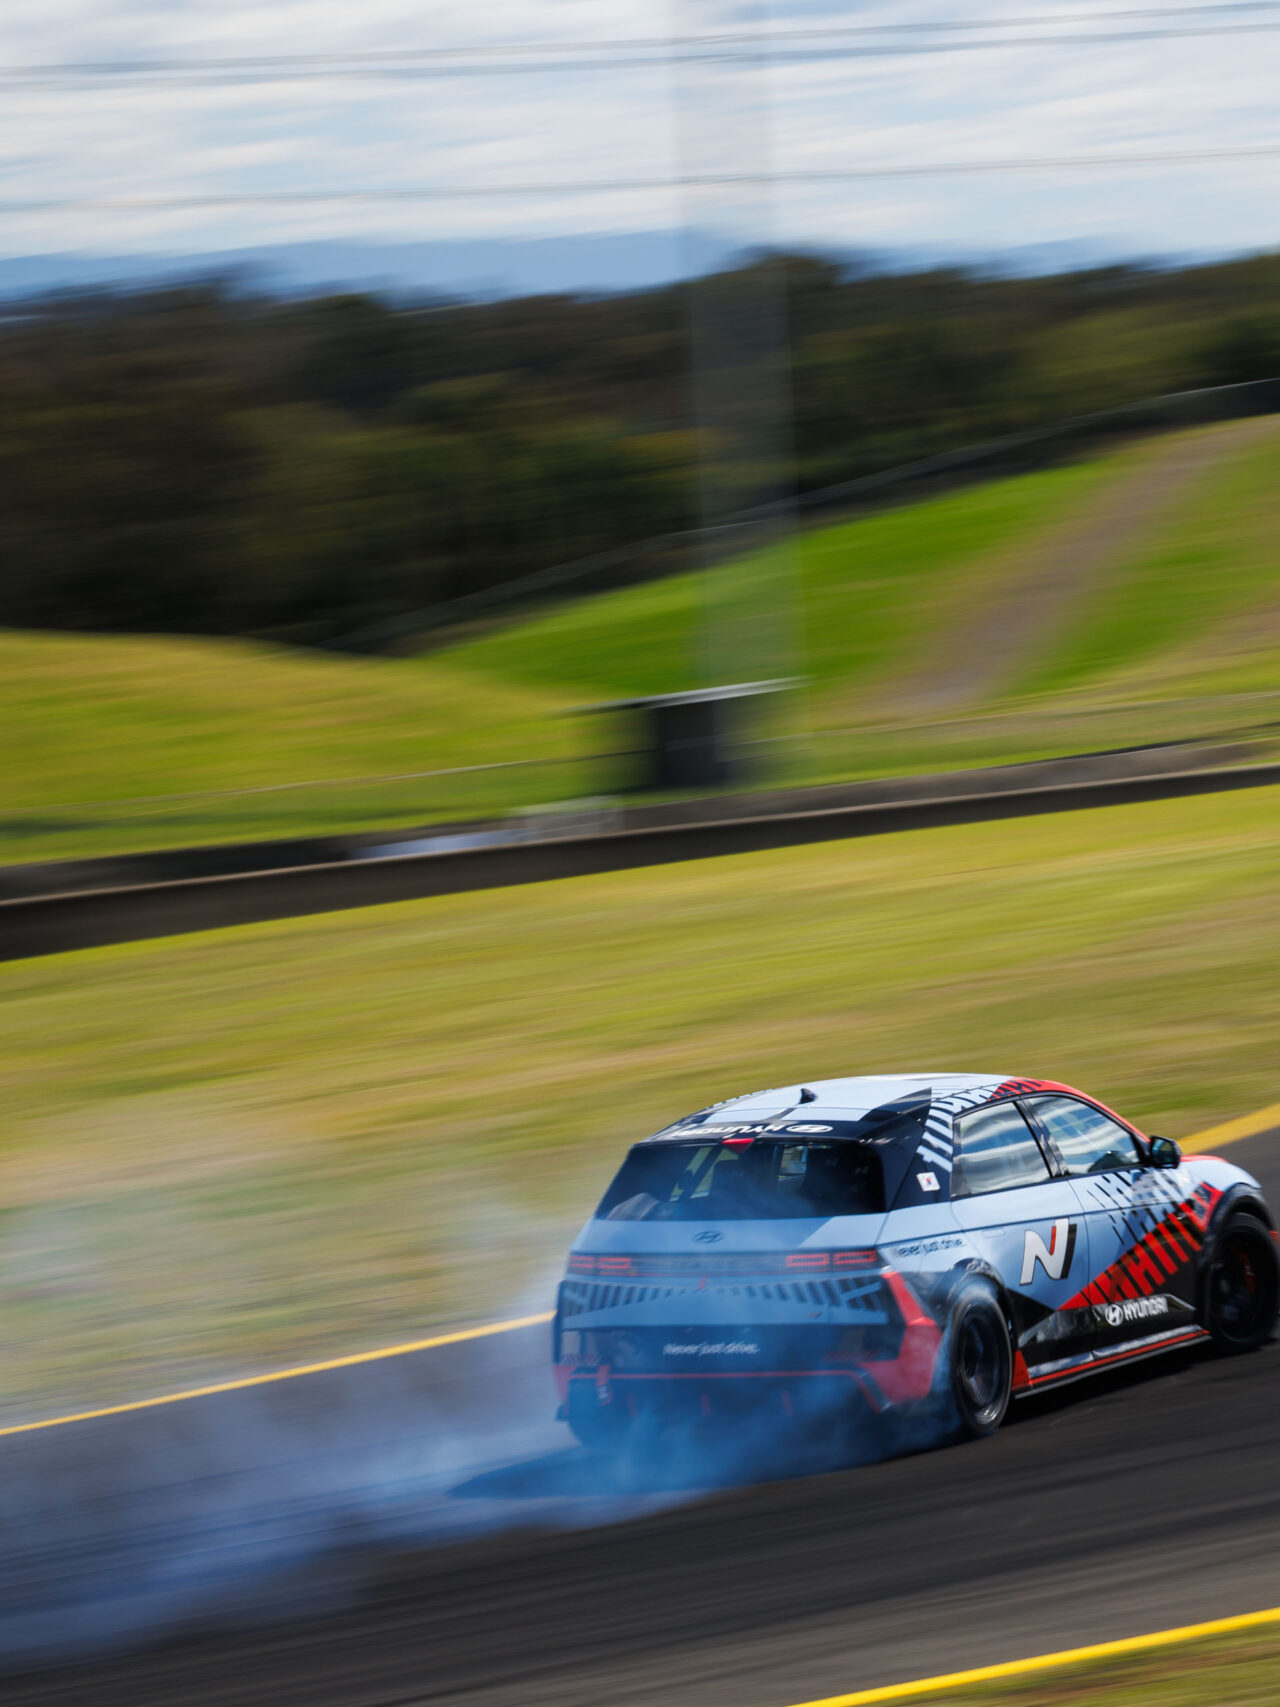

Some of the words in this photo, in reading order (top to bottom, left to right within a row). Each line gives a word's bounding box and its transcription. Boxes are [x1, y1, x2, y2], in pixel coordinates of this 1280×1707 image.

[1019, 1216, 1077, 1286] N
[1123, 1297, 1169, 1320] HYUNDAI
[662, 1343, 697, 1356] Never
[697, 1341, 725, 1356] just
